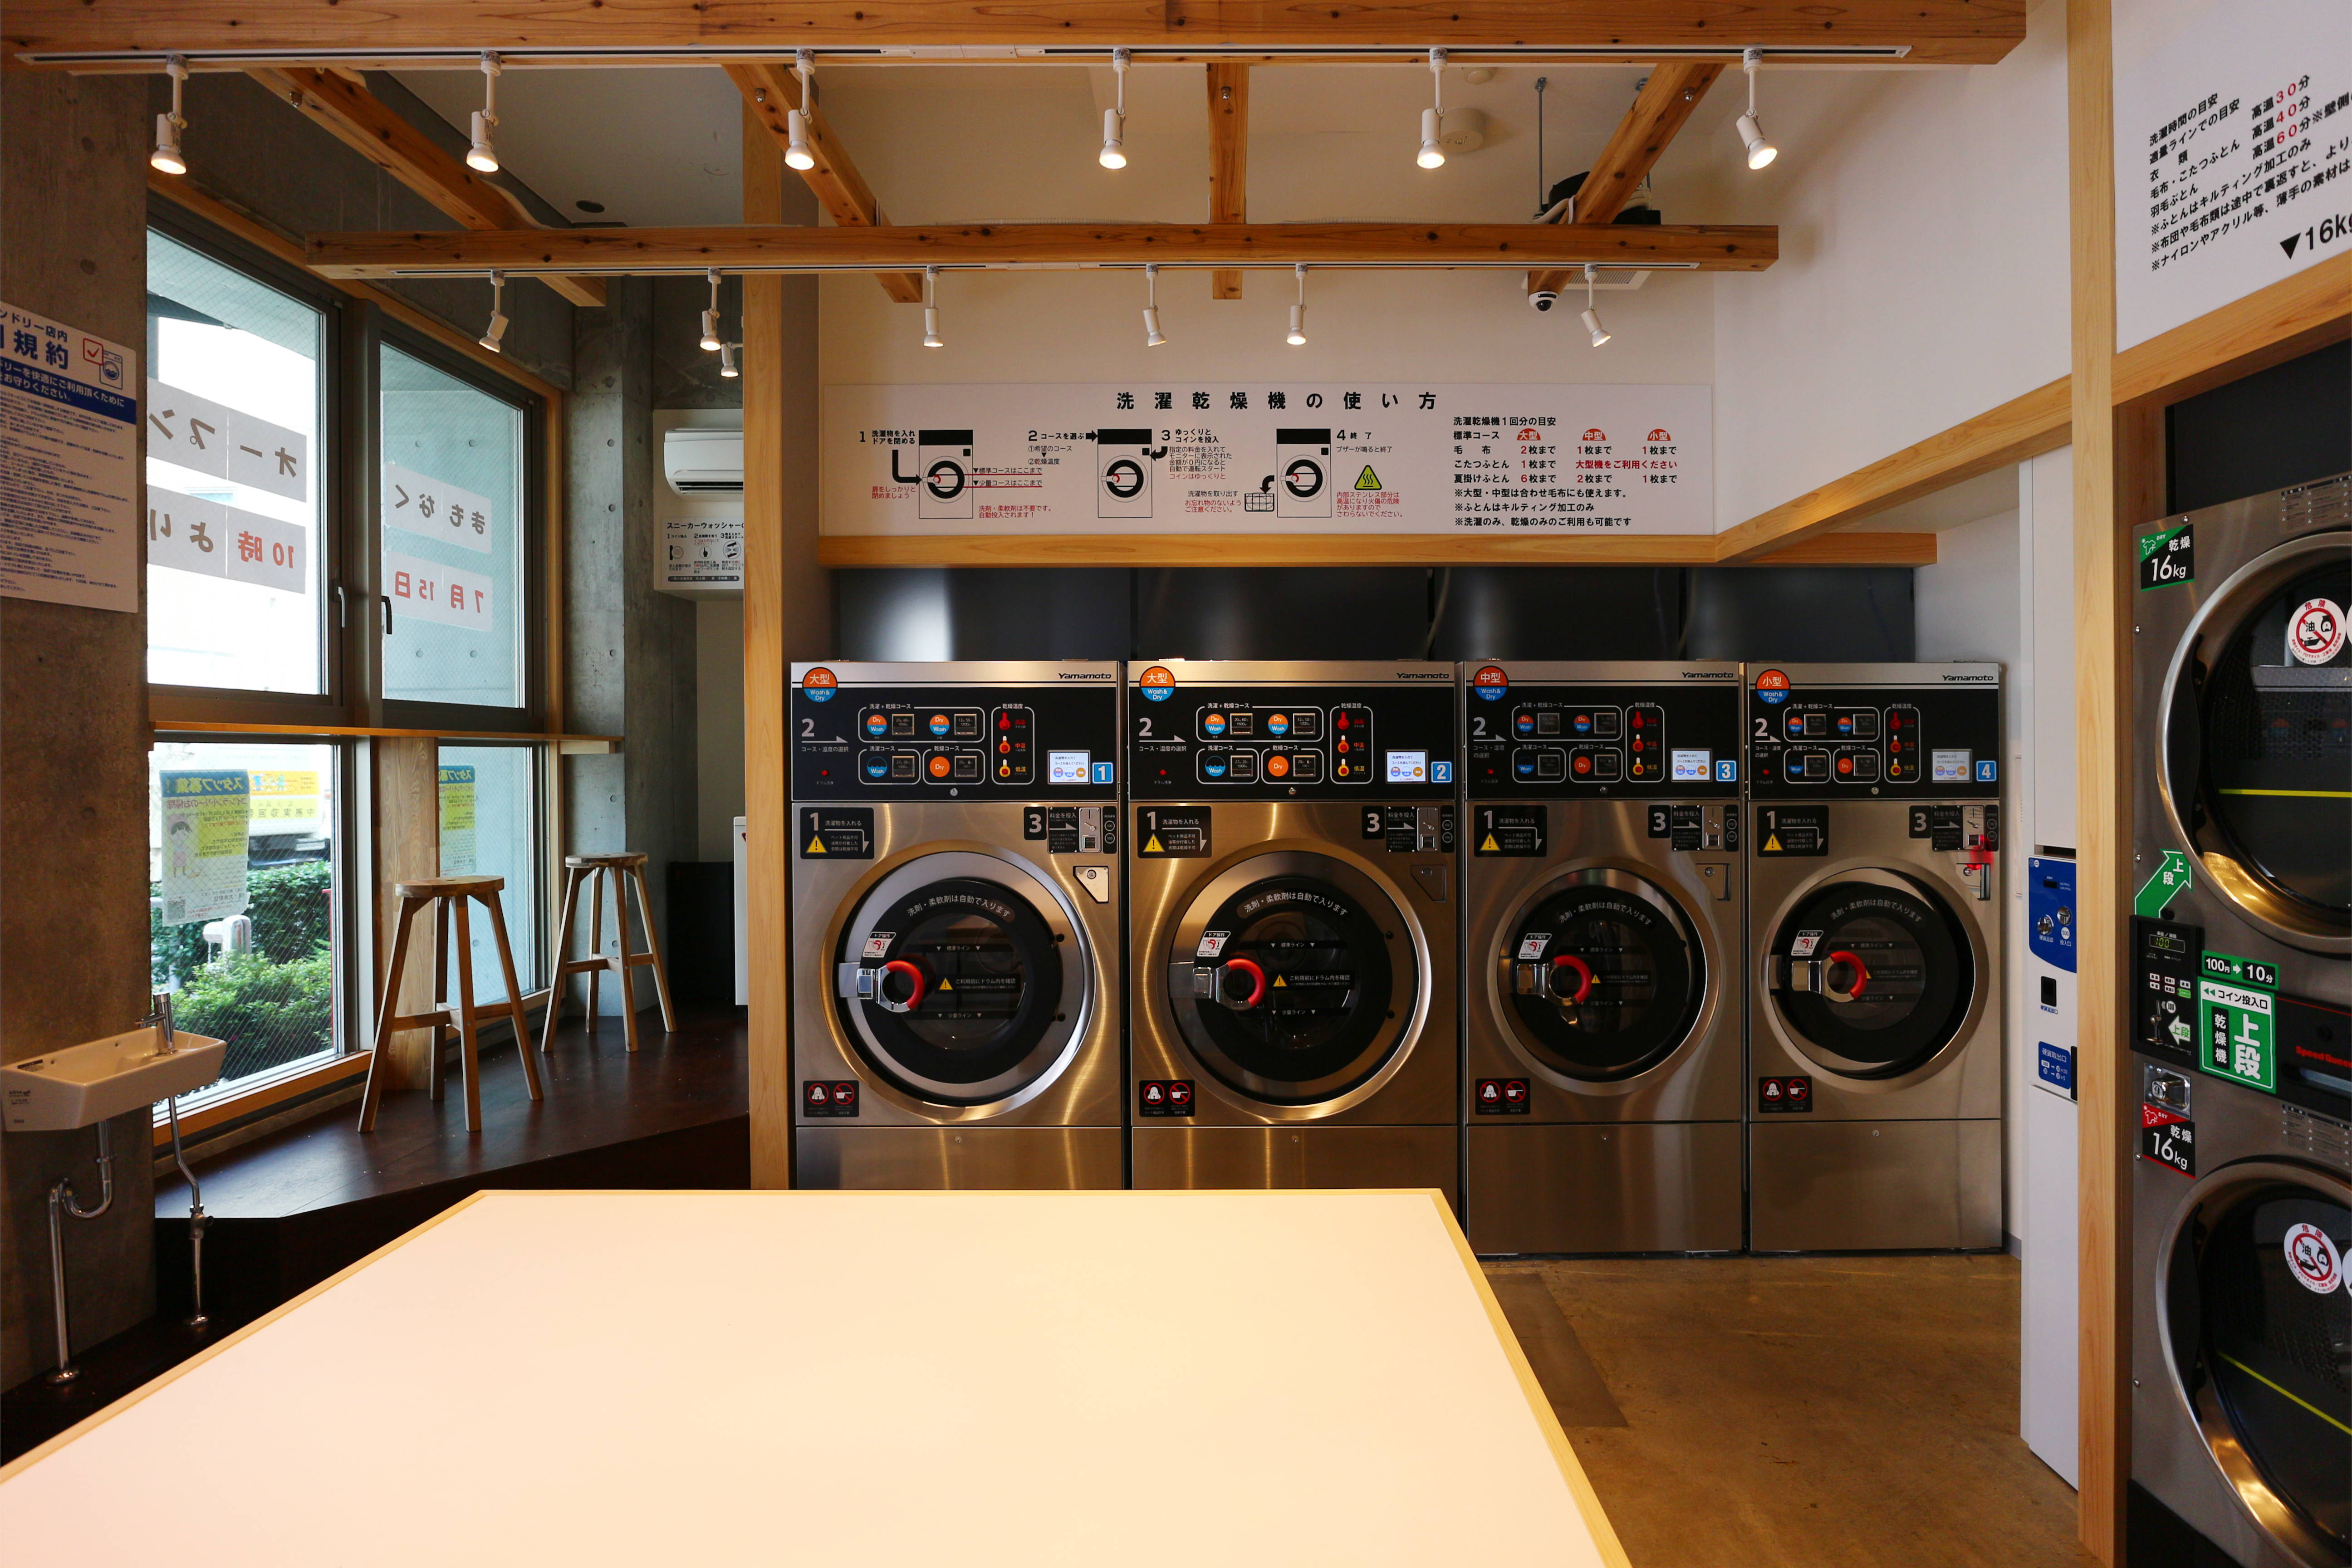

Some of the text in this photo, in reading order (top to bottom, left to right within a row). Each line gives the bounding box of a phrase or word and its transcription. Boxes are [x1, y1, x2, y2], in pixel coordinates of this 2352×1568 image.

[2149, 93, 2218, 147] 洗濯時間の目安
[2149, 98, 2240, 165] 適量ラインでの目安
[2150, 139, 2240, 200] 毛布・こたつふとん
[2151, 139, 2311, 236] ※ふとんはキルティング加工のみ
[2151, 183, 2198, 218] 羽毛ぶとん
[0, 323, 68, 370] 規約
[0, 373, 71, 401] お守りください。
[1117, 392, 1436, 410] 洗濯乾燥機の使い方
[860, 431, 866, 443] 1
[1028, 431, 1038, 441] 2
[1161, 430, 1171, 441] 3
[1337, 430, 1346, 440] 4
[1454, 431, 1668, 441] 標準コース 大型 中型 小型
[1455, 461, 1509, 469] こたつふとん
[1576, 461, 1677, 469] 大型機をご利用ください
[1454, 475, 1509, 483] 夏掛けふとん
[1455, 503, 1594, 512] ※ふとんはキルティング加工のみ
[2168, 535, 2191, 552] 乾燥
[2305, 599, 2326, 611] 危険
[2305, 621, 2315, 633] 油
[810, 674, 830, 684] 大型
[1147, 673, 1167, 684] 大型
[1480, 672, 1500, 683] 中型
[1763, 676, 1782, 686] 小型
[801, 718, 815, 737] 2
[1139, 717, 1152, 736] 2
[1473, 717, 1486, 735] 2
[1755, 718, 1768, 737] 2
[1098, 765, 1106, 780] 1
[1436, 764, 1446, 779] 2
[1721, 764, 1731, 779] 3
[1981, 764, 1991, 779] 4
[810, 813, 818, 831] 1
[1029, 813, 1042, 833] 3
[1147, 812, 1156, 830] 1
[1367, 813, 1380, 832] 3
[1484, 810, 1493, 829] 1
[1653, 812, 1666, 831] 3
[1767, 811, 1775, 829] 1
[1914, 813, 1926, 831] 3
[2163, 859, 2184, 886] 上段
[2156, 938, 2170, 948] 100
[2205, 959, 2273, 983] 100円 10分
[2218, 990, 2268, 1009] コイン投入口
[2172, 1024, 2190, 1039] 上段
[2214, 1014, 2227, 1064] 乾燥機
[2234, 1014, 2261, 1080] 上段
[2170, 1124, 2192, 1143] 乾燥
[2302, 1224, 2323, 1240] 危険
[2302, 1244, 2312, 1256] 油
